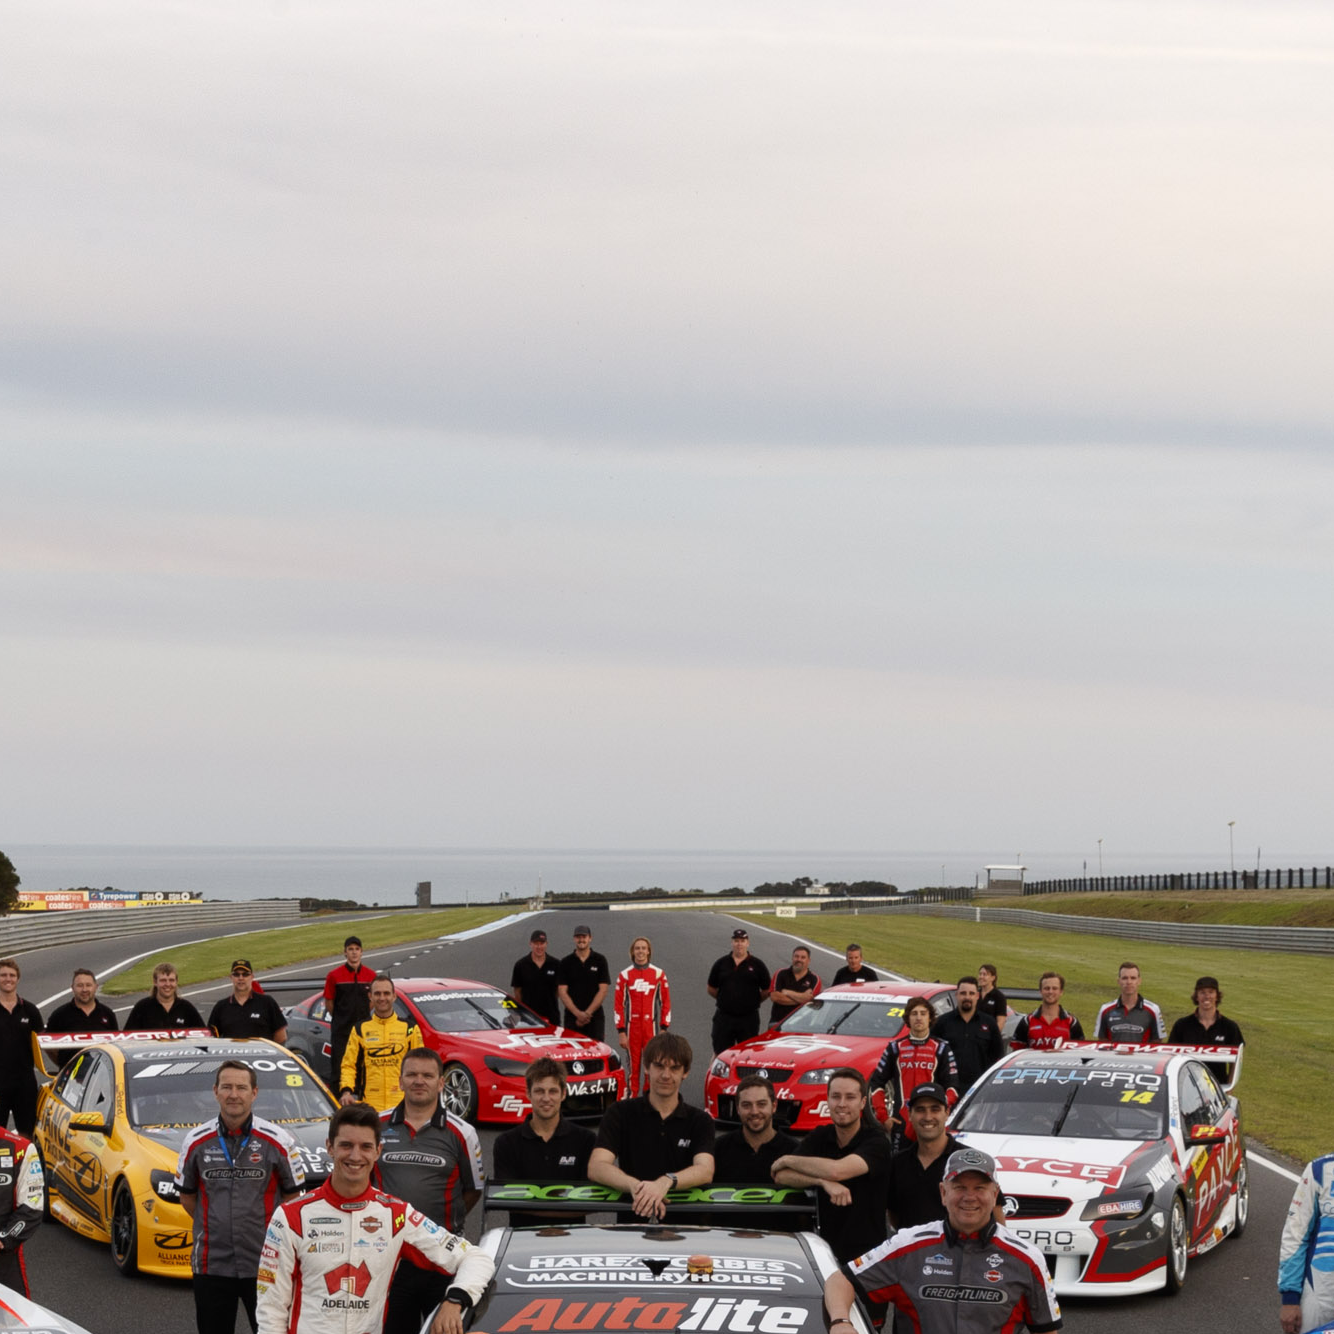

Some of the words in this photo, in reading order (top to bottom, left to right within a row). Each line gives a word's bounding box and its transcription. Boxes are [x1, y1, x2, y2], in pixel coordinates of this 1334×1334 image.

[501, 1000, 518, 1009] 21
[887, 1008, 905, 1018] 21
[38, 1031, 206, 1043] RACEWORKS
[286, 1074, 304, 1087] 8
[1120, 1090, 1156, 1105] 14
[385, 1153, 441, 1165] FREIGHTLINER
[997, 1156, 1113, 1180] AYCE
[1100, 1204, 1120, 1214] EBA
[1120, 1200, 1142, 1211] HIRE
[157, 1252, 193, 1261] ALLIANC
[925, 1288, 1001, 1301] FREIGHTLINER
[322, 1298, 370, 1309] ADELAIDE
[498, 1297, 810, 1334] Autolite
